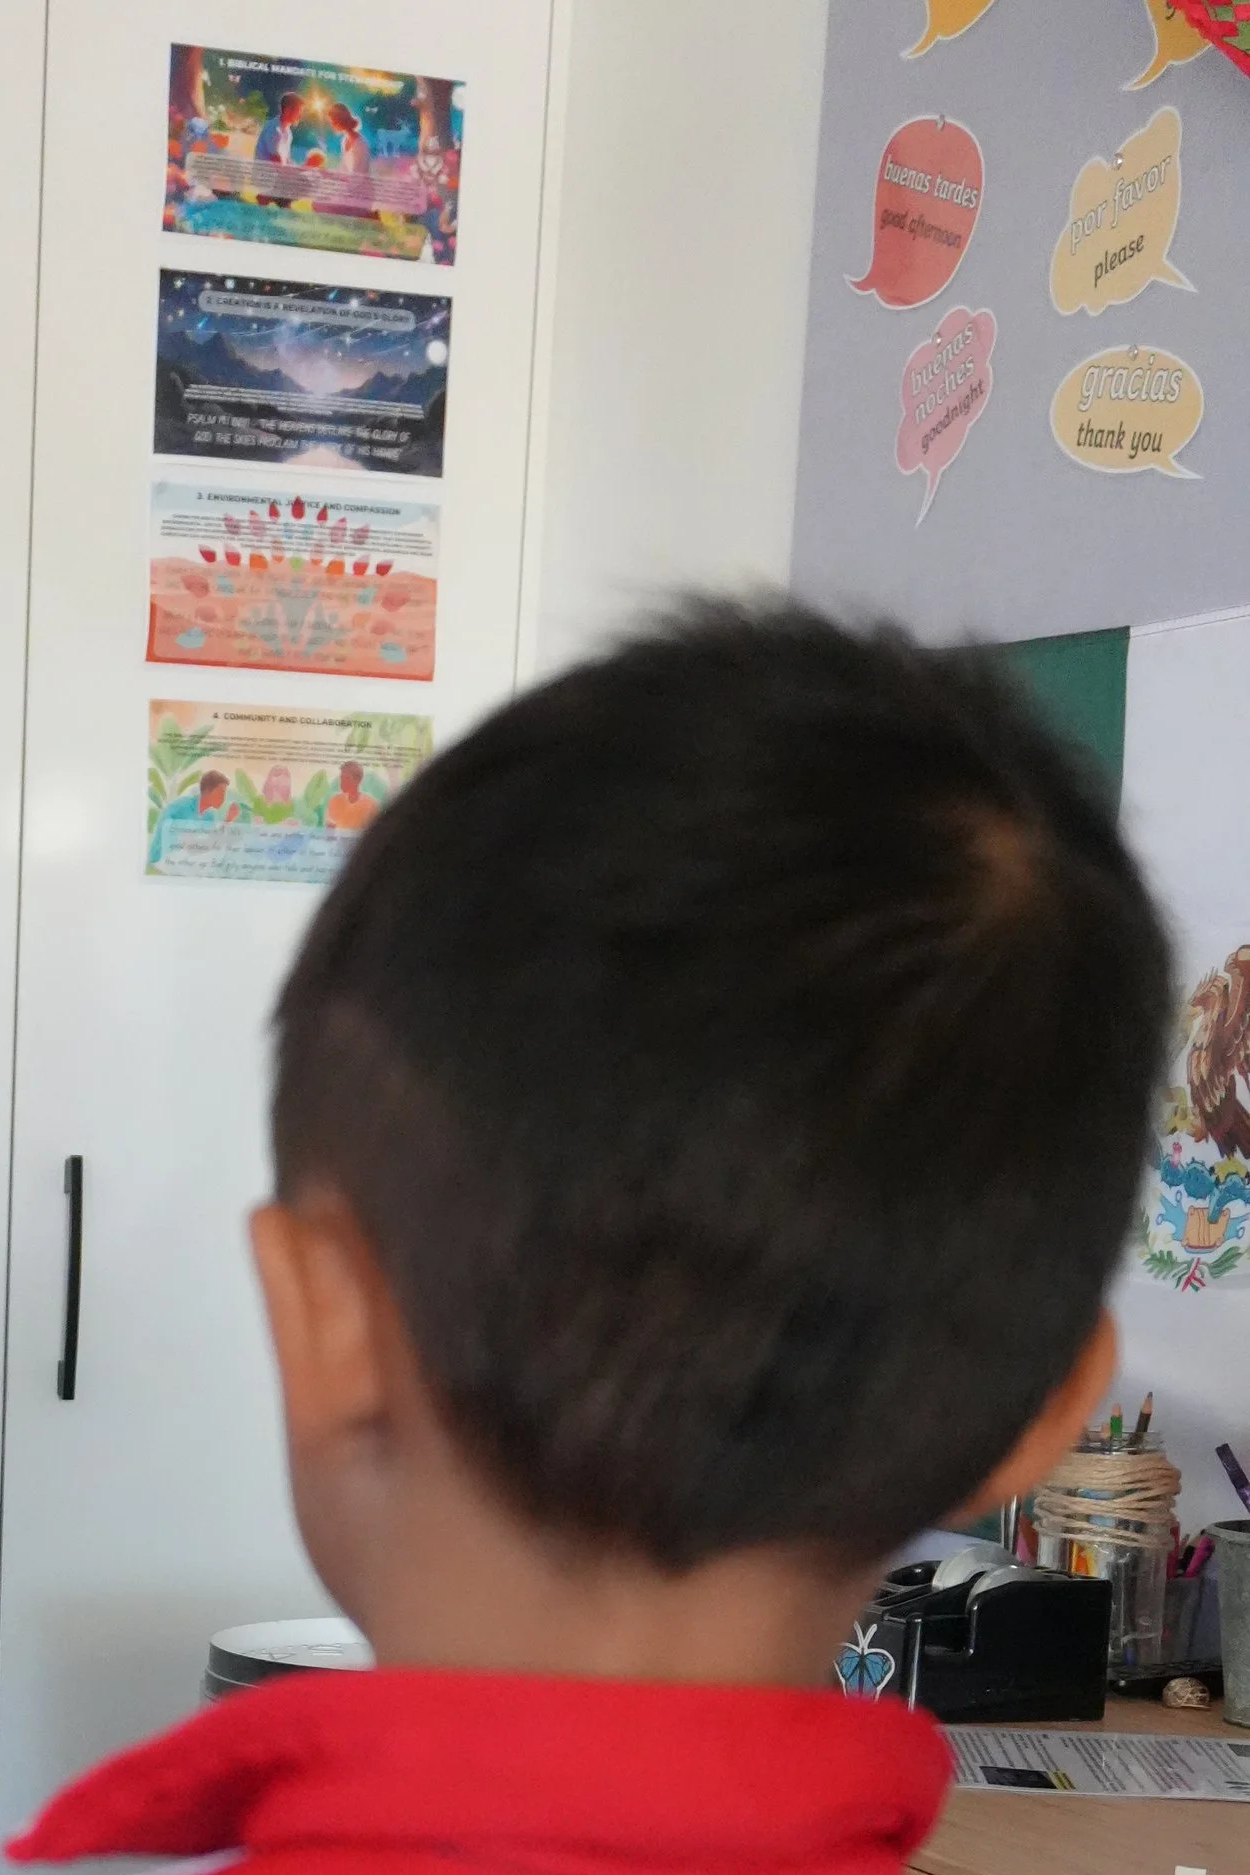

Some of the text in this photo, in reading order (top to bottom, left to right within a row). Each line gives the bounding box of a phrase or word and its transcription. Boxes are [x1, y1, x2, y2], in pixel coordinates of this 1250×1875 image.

[884, 154, 978, 209] buenas tardes
[1070, 154, 1172, 256] por favor
[880, 209, 962, 249] good afternoon
[1094, 234, 1145, 288] please
[911, 321, 974, 396] buenas
[1077, 353, 1183, 412] gracias
[915, 355, 974, 425] noches
[921, 379, 984, 455] goodnight
[1077, 418, 1163, 459] thank you
[207, 493, 283, 506] ENVIRONMENTAL
[285, 499, 320, 509] JUTICE
[345, 504, 401, 515] COMPASSION
[224, 712, 276, 723] COMMUNITY
[279, 716, 298, 724] AND
[300, 716, 372, 729] COLLABORATION
